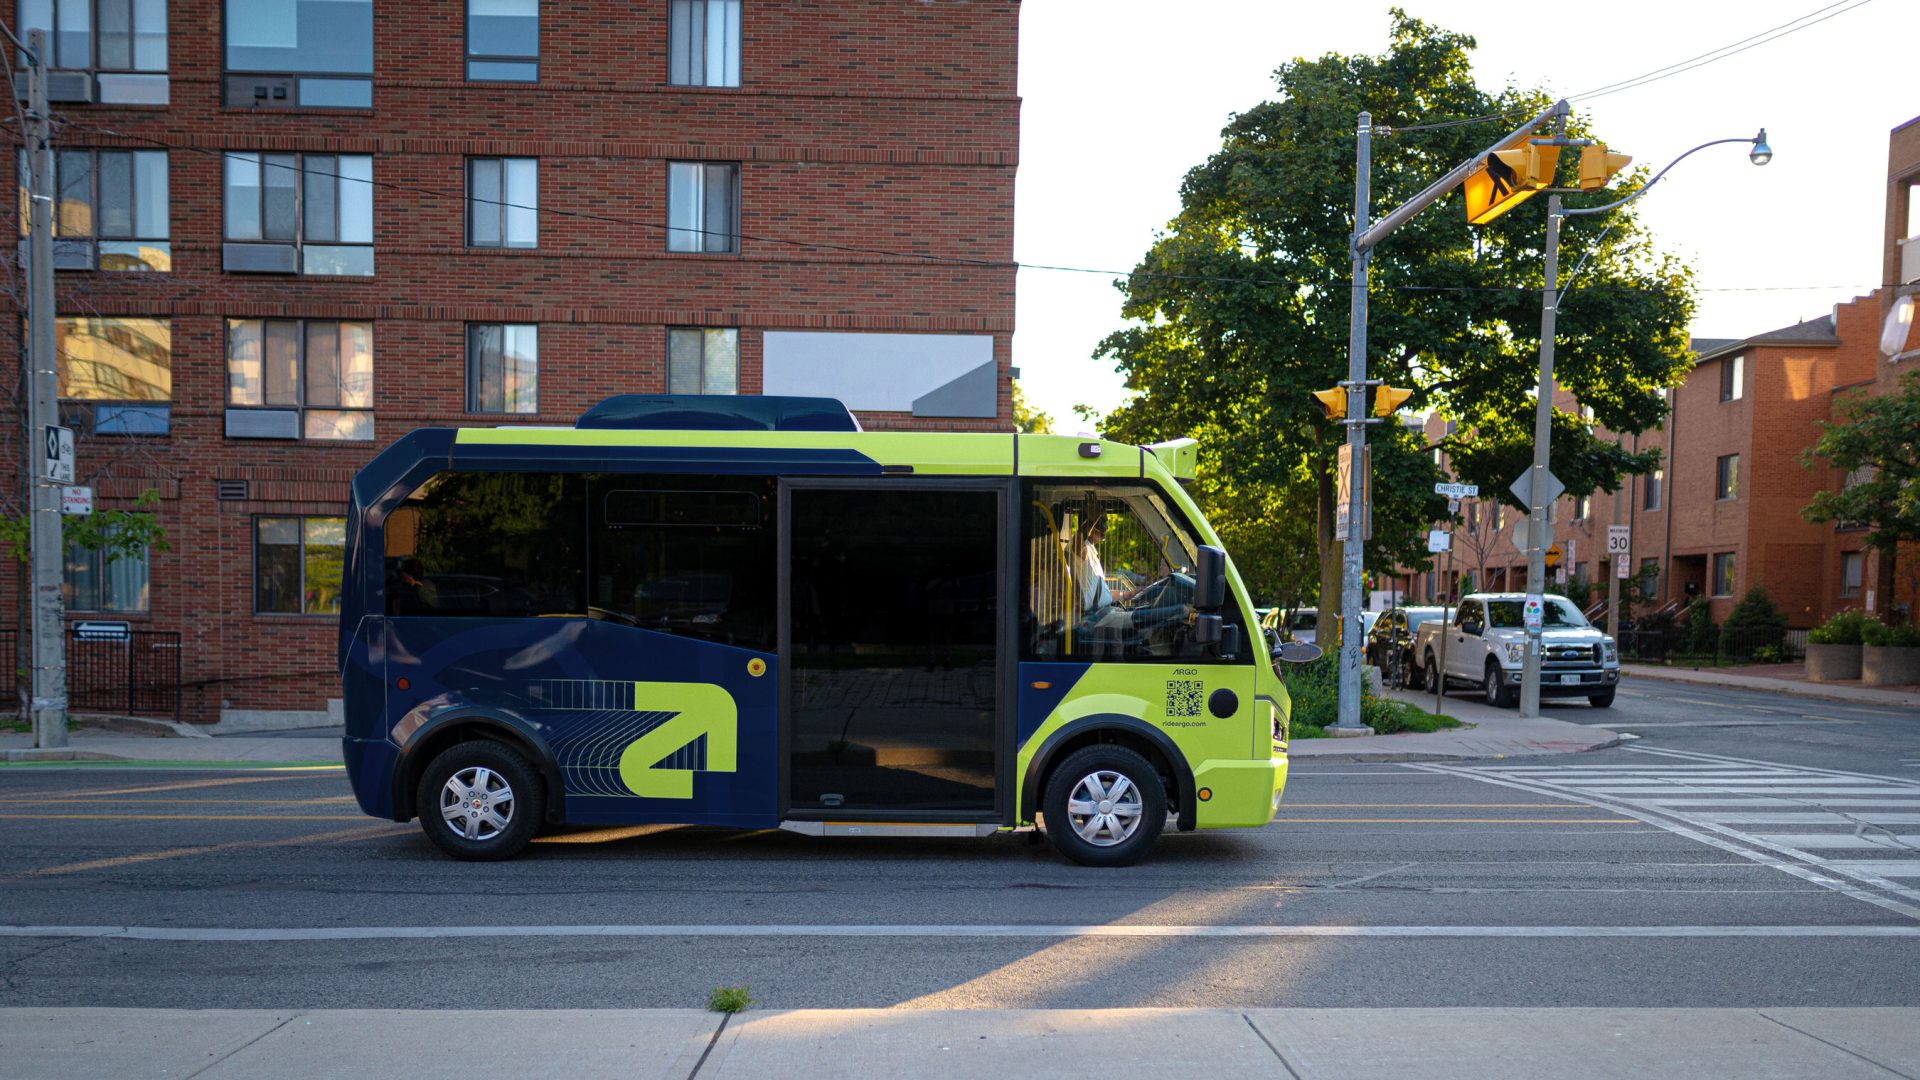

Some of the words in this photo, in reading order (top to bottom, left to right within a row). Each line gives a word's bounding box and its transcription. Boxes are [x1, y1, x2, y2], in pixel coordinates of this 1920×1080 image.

[1436, 484, 1465, 494] CHRISTIE
[63, 496, 90, 504] STANDING
[1610, 537, 1628, 550] 30
[1162, 720, 1207, 728] rideargo.com
